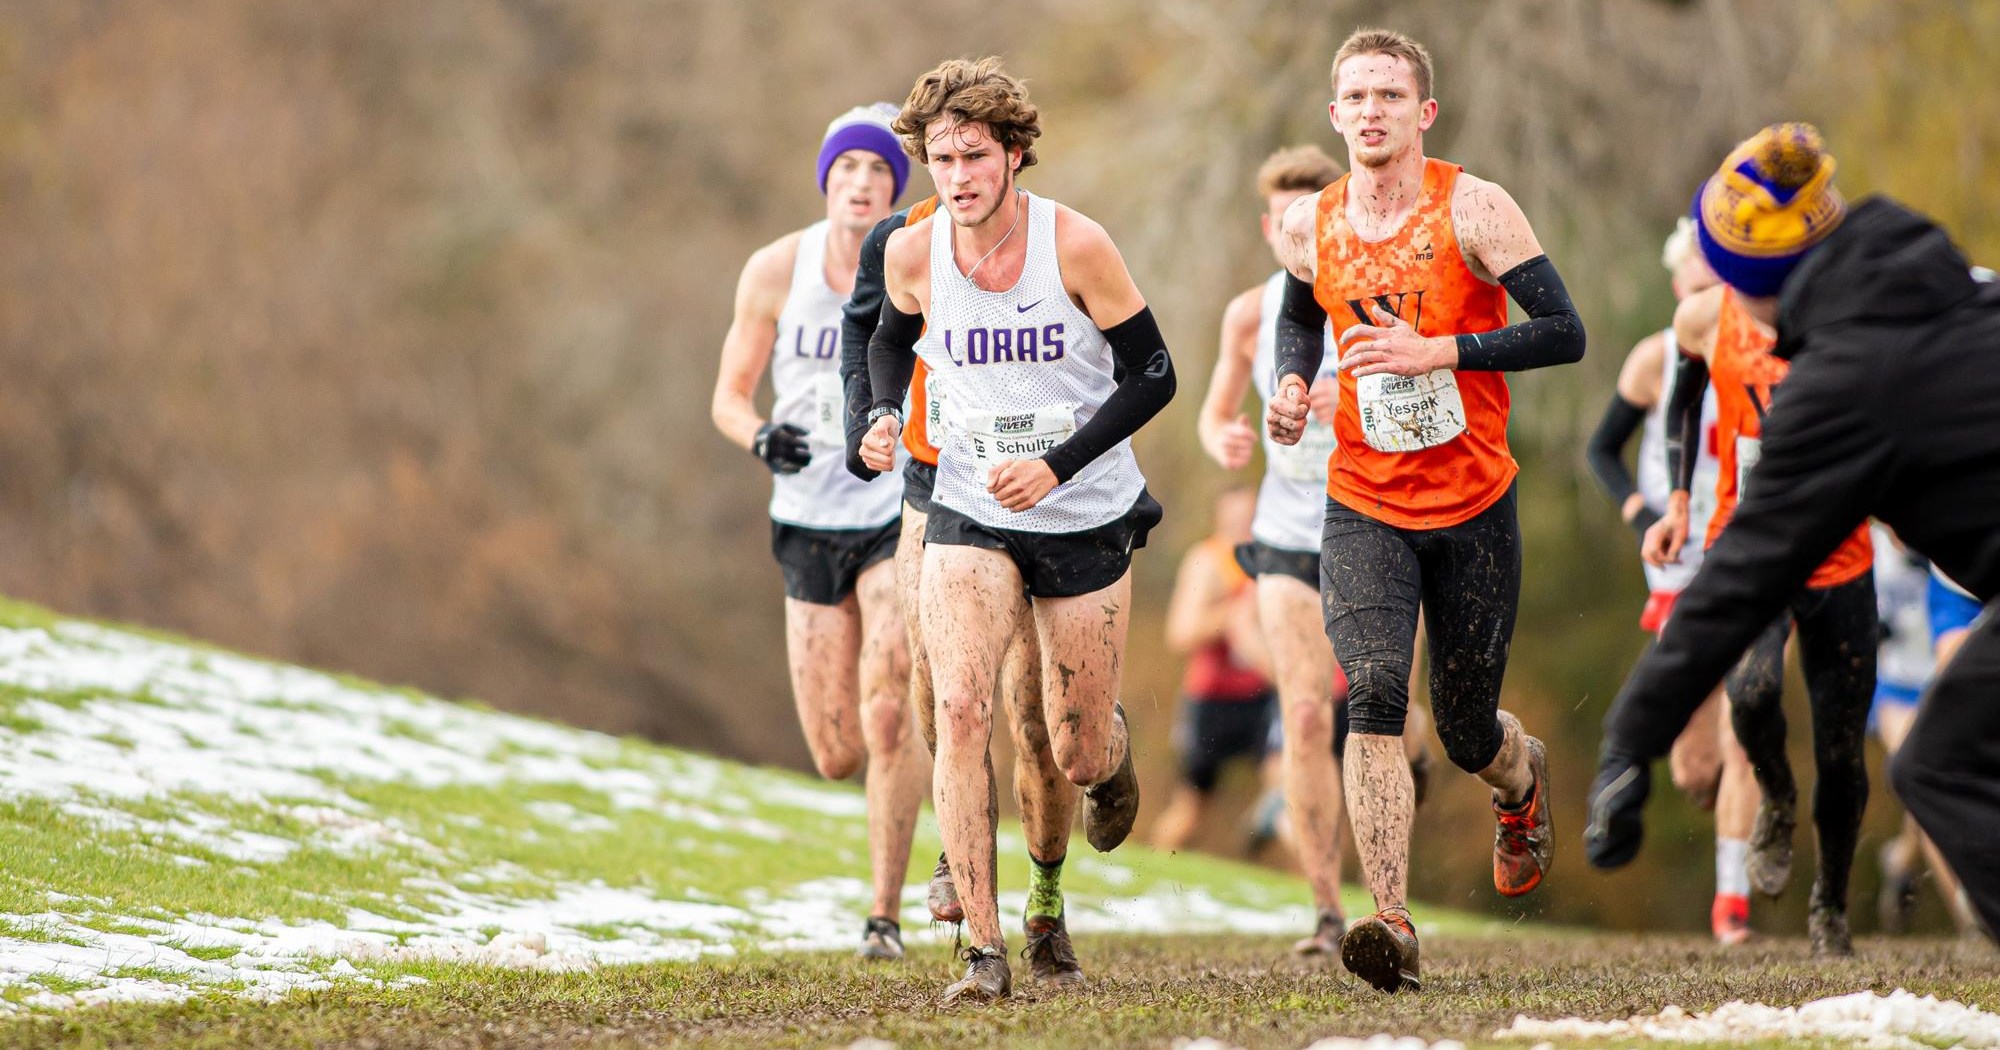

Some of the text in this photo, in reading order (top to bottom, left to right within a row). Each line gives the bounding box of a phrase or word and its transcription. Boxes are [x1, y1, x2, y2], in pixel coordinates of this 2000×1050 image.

[944, 323, 1064, 367] LORAS
[931, 400, 941, 424] 380
[1385, 396, 1438, 416] Yessak
[993, 420, 1034, 432] RIVERS
[995, 413, 1035, 421] AMERICAN
[1363, 407, 1376, 431] 390
[974, 437, 986, 459] 167
[996, 439, 1055, 454] Schultz
